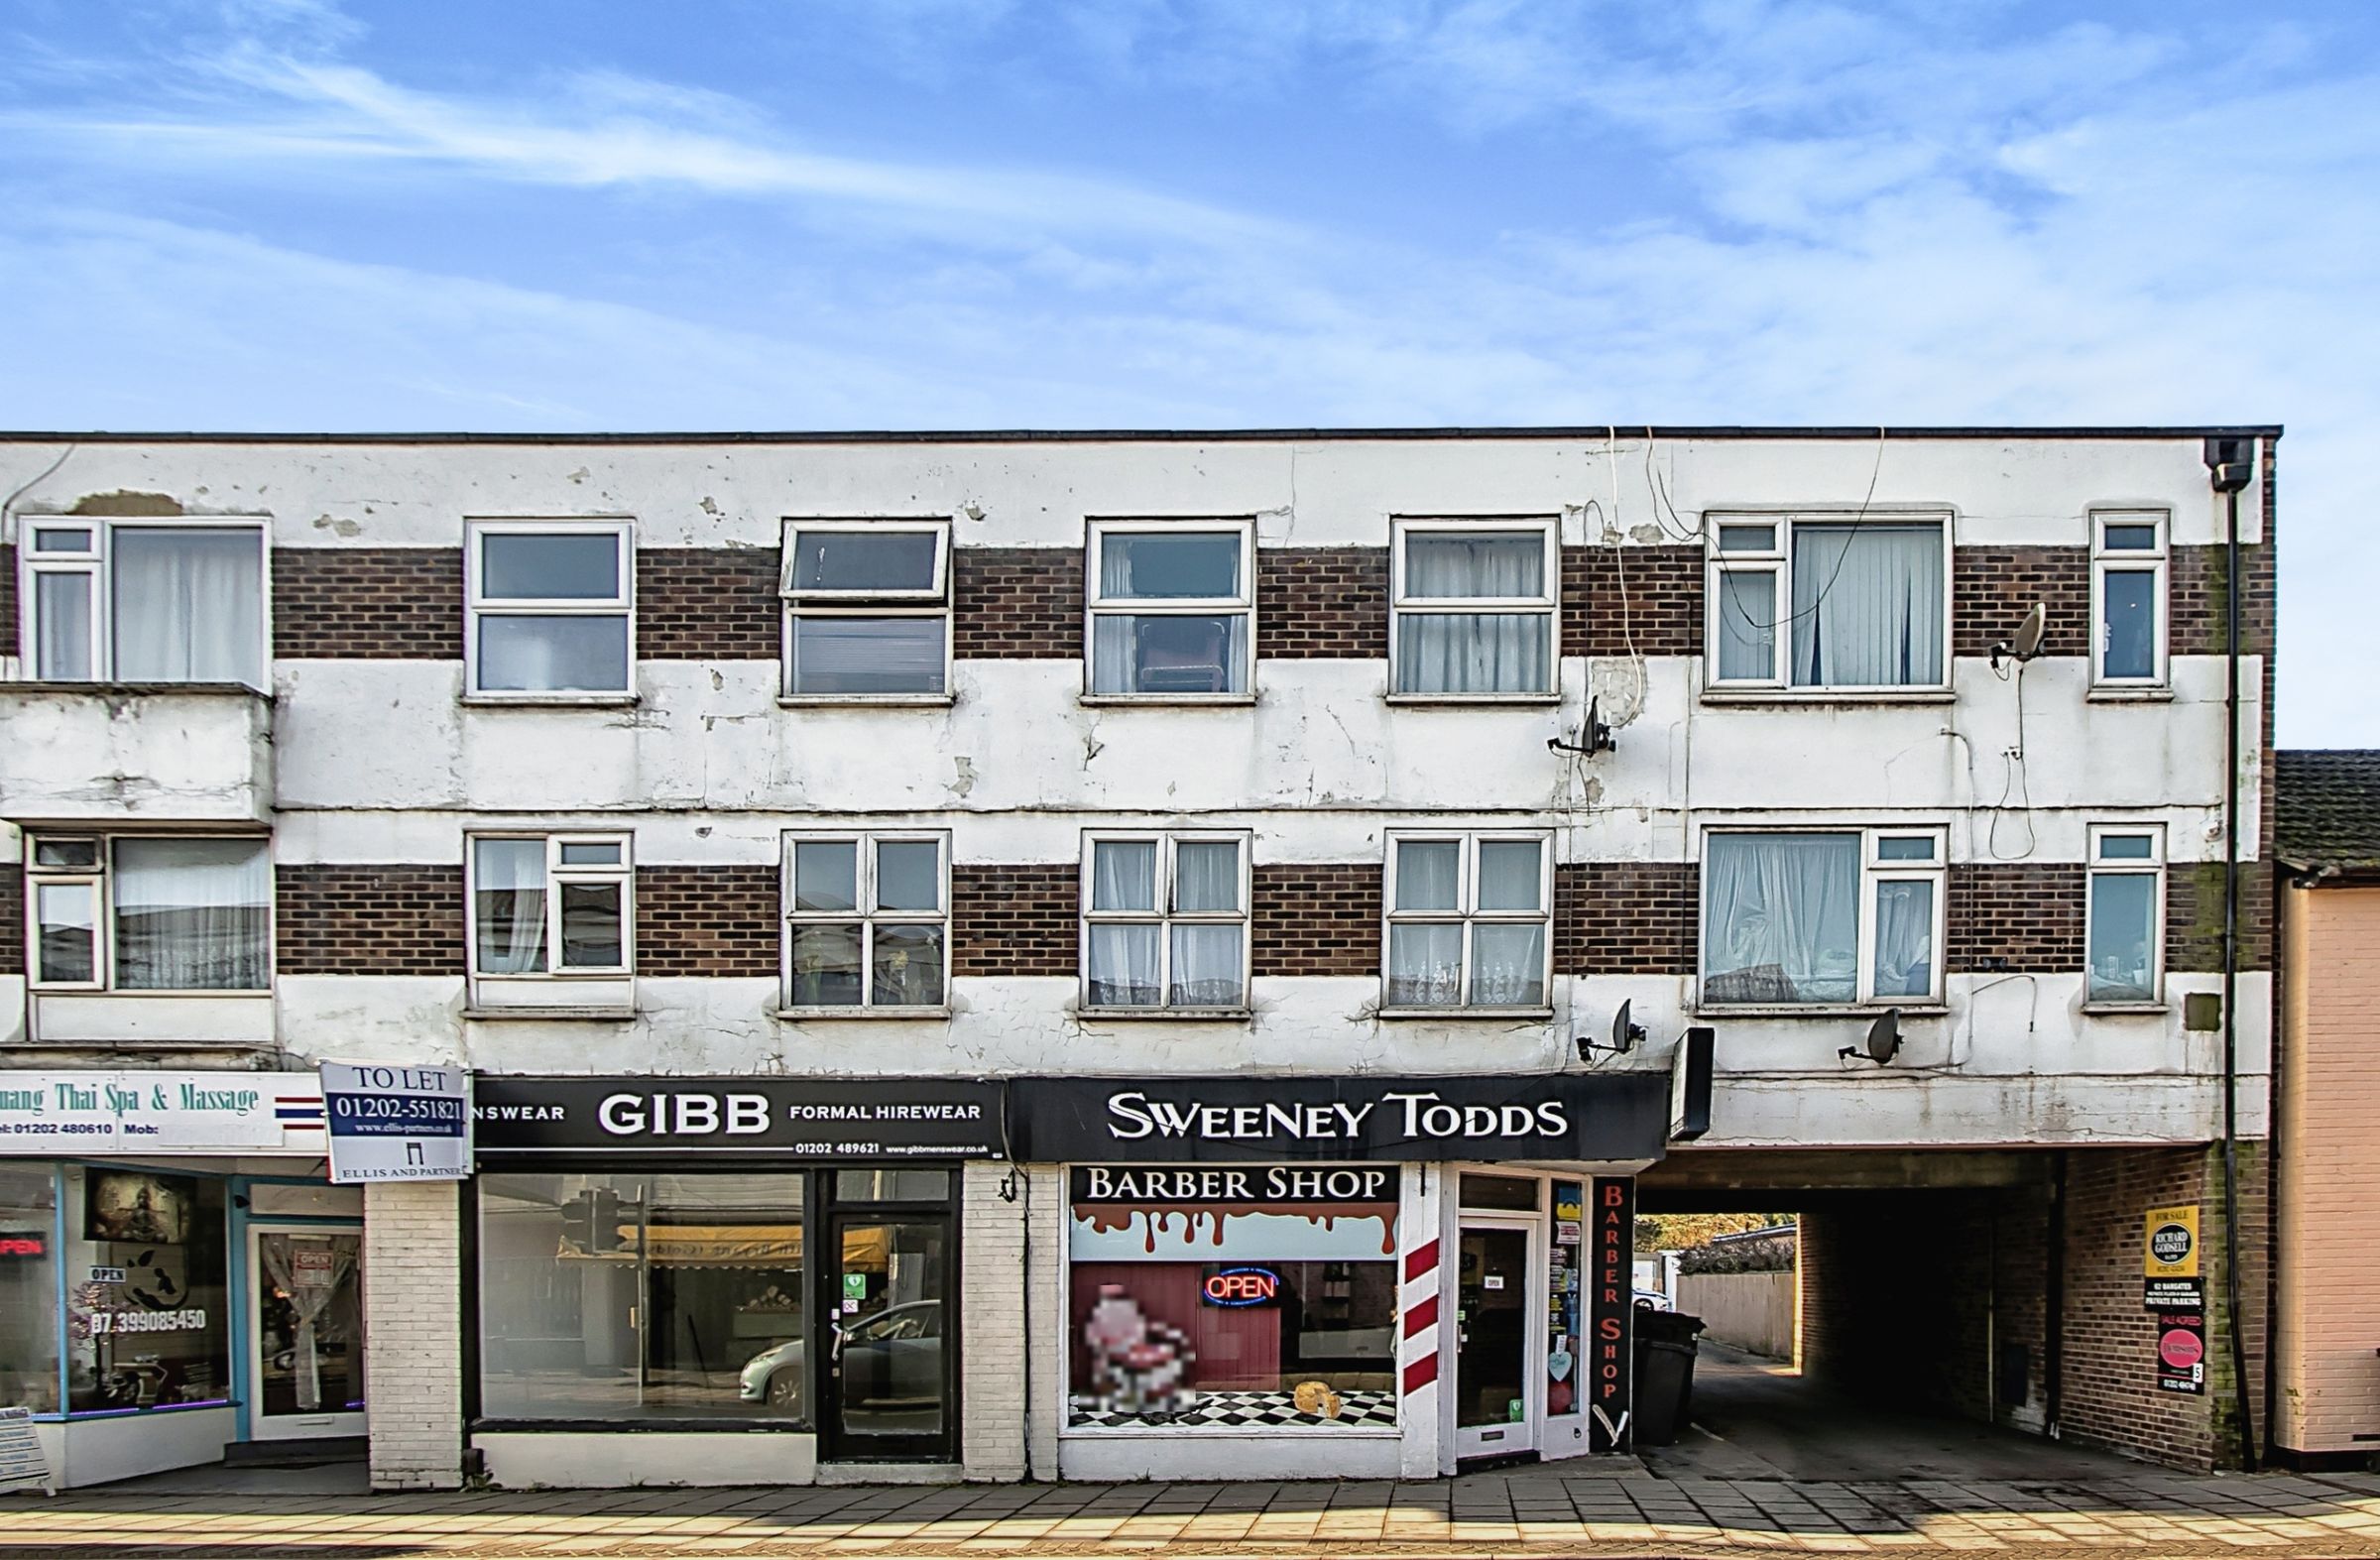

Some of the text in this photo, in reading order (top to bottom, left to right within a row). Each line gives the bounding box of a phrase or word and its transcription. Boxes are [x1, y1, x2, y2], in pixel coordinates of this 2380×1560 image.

[352, 1066, 447, 1092] TO LET
[55, 1083, 97, 1110] Thai
[105, 1083, 139, 1118] Spa
[152, 1083, 169, 1110] &
[180, 1083, 260, 1117] Massage
[335, 1097, 461, 1120] 01202-551821
[598, 1093, 771, 1136] GIBB
[790, 1105, 981, 1120] FORMAL HIREWEAR
[1107, 1091, 1569, 1140] SWEENEY TODDS
[14, 1124, 58, 1135] 01202
[123, 1124, 159, 1135] Mob:
[795, 1142, 989, 1155] 01202 489621 www.gibbmenswear.co.uk
[342, 1168, 388, 1179] ELLIS
[389, 1167, 418, 1178] AND
[1086, 1167, 1386, 1200] BARBER SHOP
[2170, 1209, 2189, 1221] SALE
[1605, 1184, 1623, 1304] BARBER
[91, 1268, 124, 1280] OPEN
[1207, 1275, 1275, 1298] OPEN
[118, 1309, 206, 1333] 399085450
[1600, 1317, 1621, 1398] SHOP
